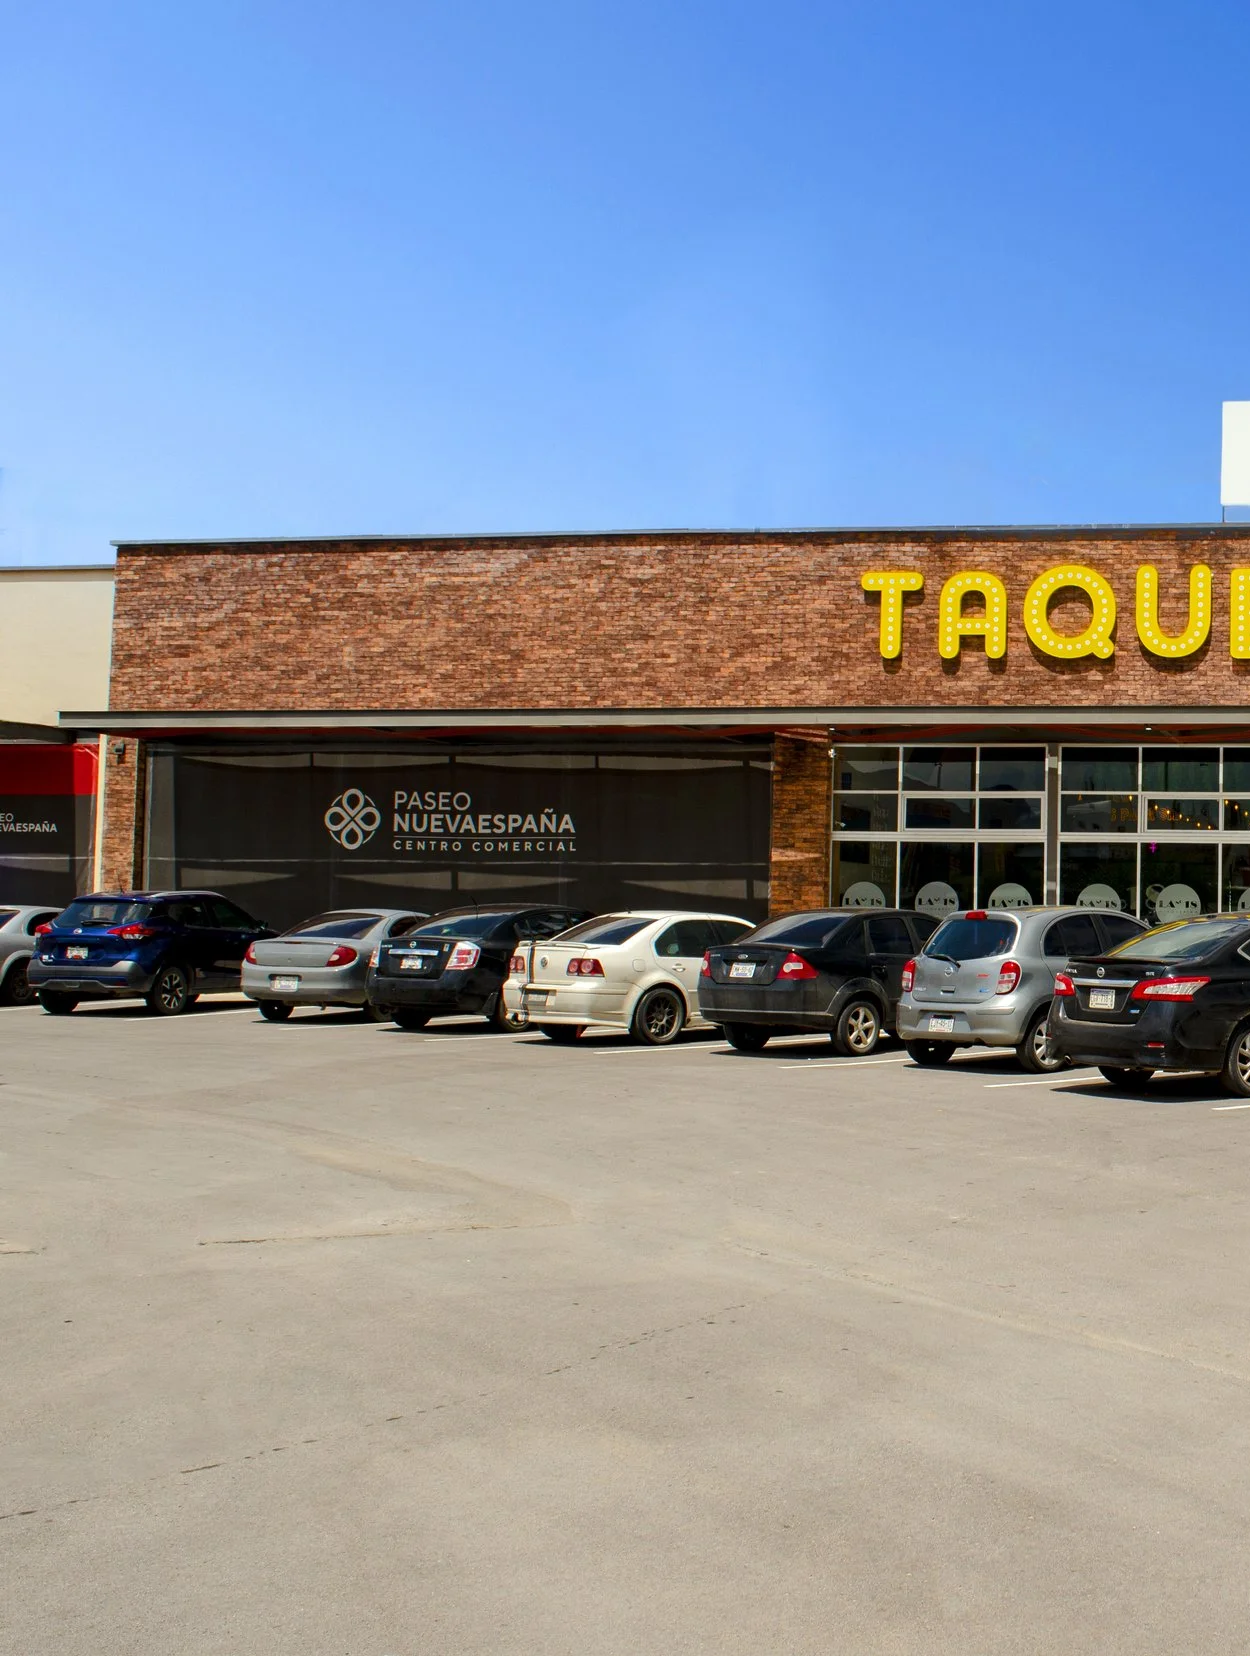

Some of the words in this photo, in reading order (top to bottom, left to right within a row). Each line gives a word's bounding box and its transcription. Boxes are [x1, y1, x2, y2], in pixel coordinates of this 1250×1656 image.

[394, 791, 471, 811] PASEO
[0, 821, 58, 833] VAESPAÑA
[393, 808, 577, 834] NUEVAESPAÑA
[393, 840, 462, 851] CENTRO
[472, 841, 577, 852] COMERCIAL
